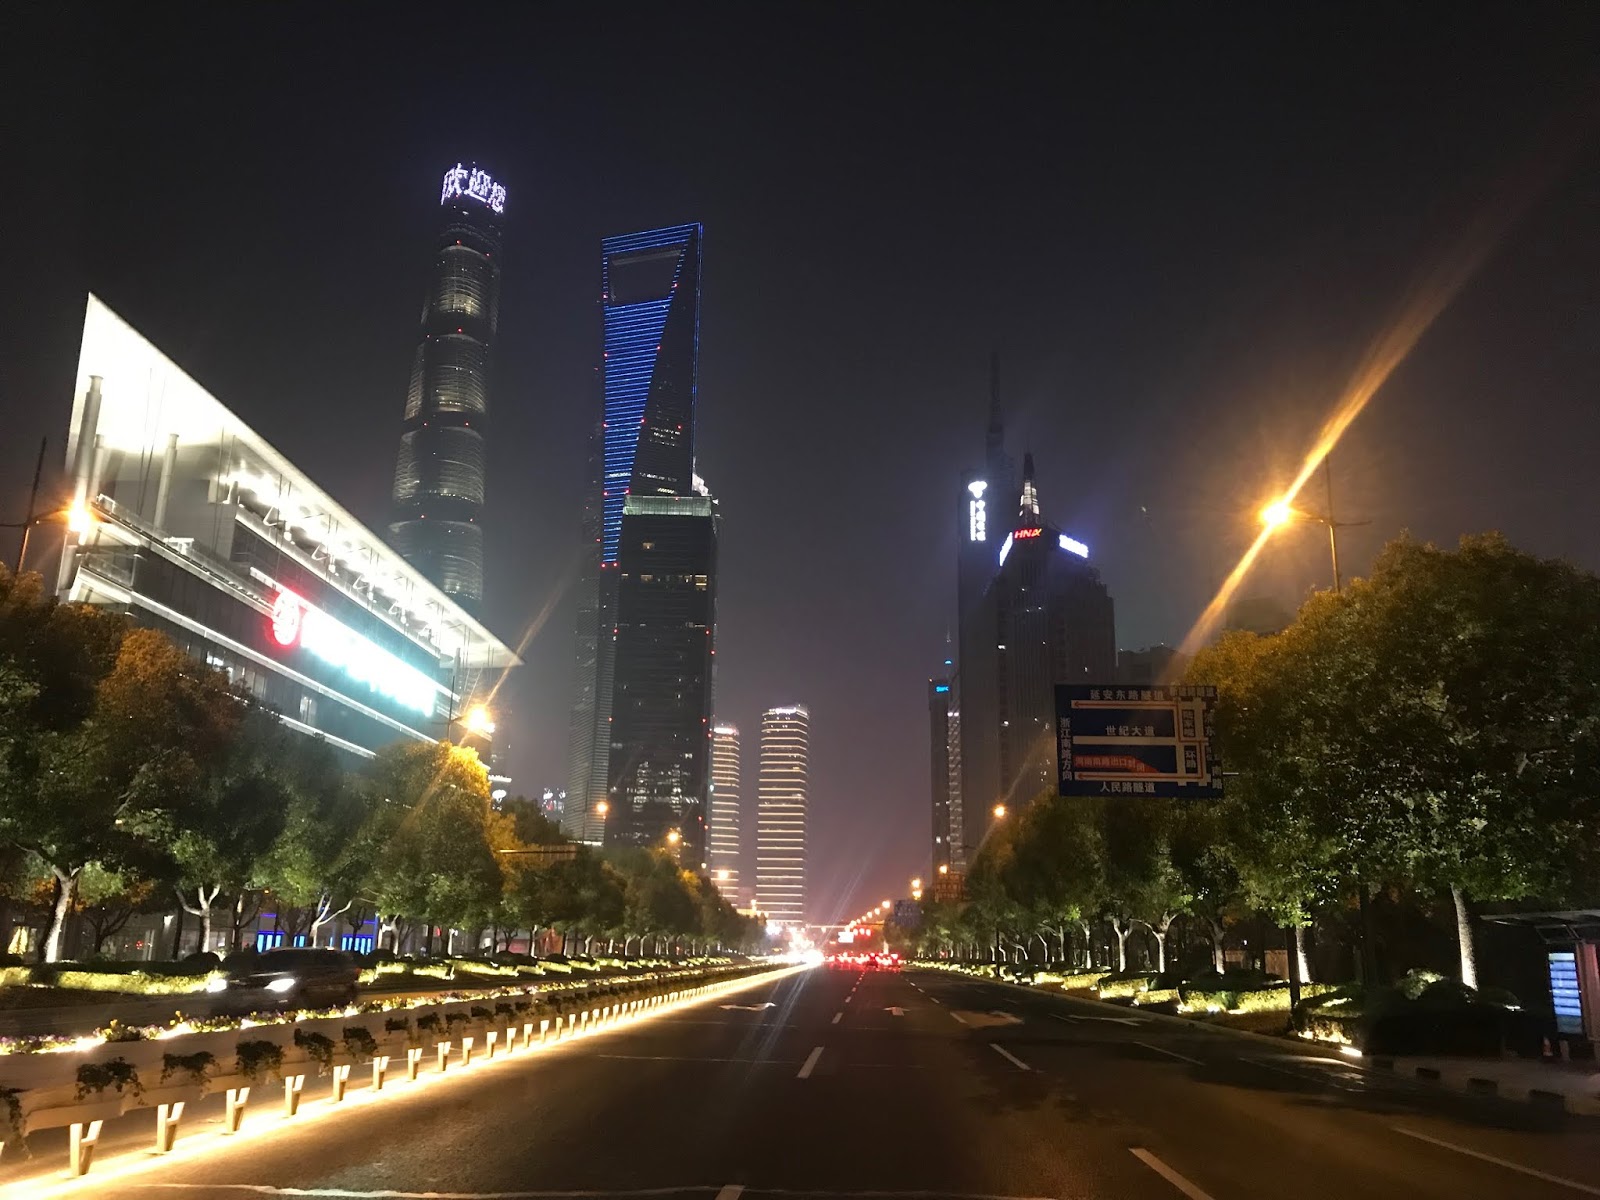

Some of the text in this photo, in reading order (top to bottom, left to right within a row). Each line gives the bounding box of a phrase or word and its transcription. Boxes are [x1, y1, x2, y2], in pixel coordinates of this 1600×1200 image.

[1105, 726, 1156, 737] 世纪大道
[1100, 782, 1156, 793] 人民路隧道
